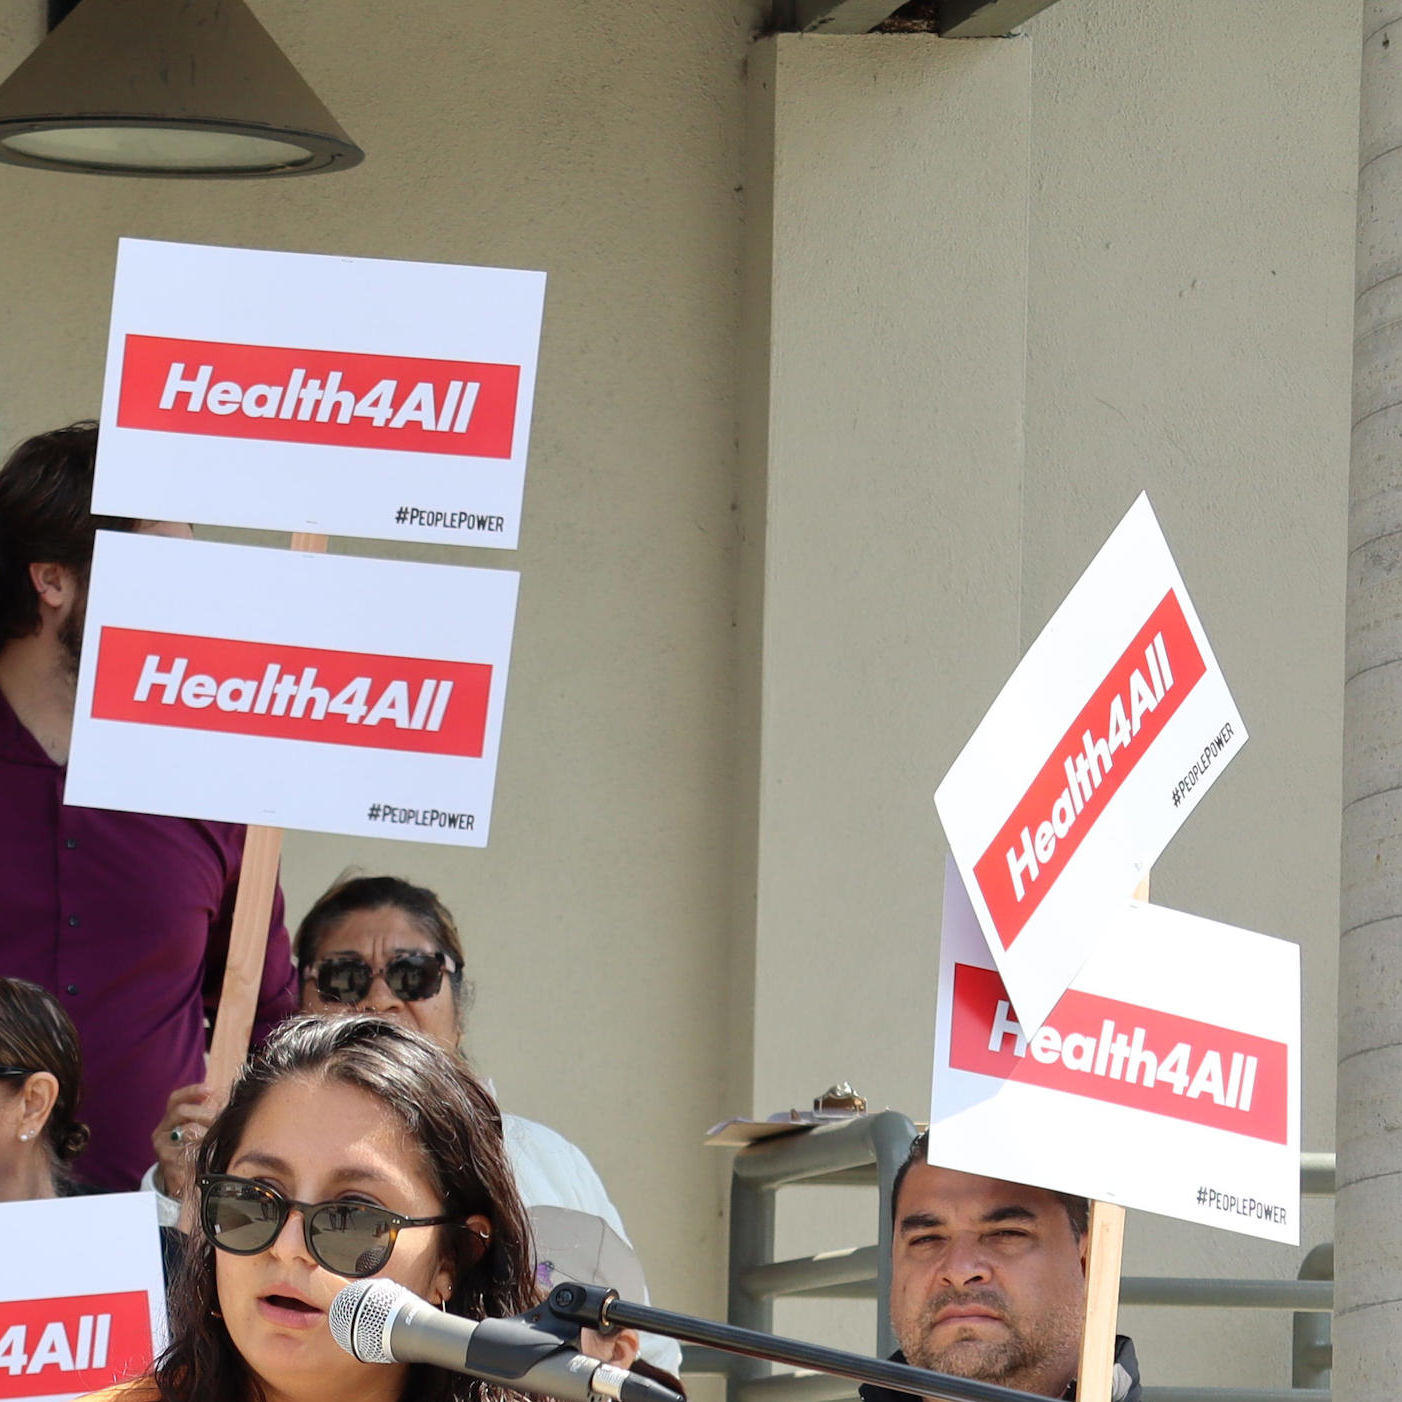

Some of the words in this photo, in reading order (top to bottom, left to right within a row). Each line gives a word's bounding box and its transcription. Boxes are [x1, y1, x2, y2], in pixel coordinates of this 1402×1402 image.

[158, 361, 481, 434] Health4All
[394, 505, 505, 533] #PEOPLEPOWER
[133, 653, 455, 733] Health4All
[1005, 631, 1175, 903] Health4All
[1171, 721, 1235, 808] #PEOPLEPOWER
[367, 804, 476, 831] #PEOPLEPOWER
[988, 998, 1257, 1114] Health4All
[1196, 1185, 1288, 1228] #PEOPLEPOWER
